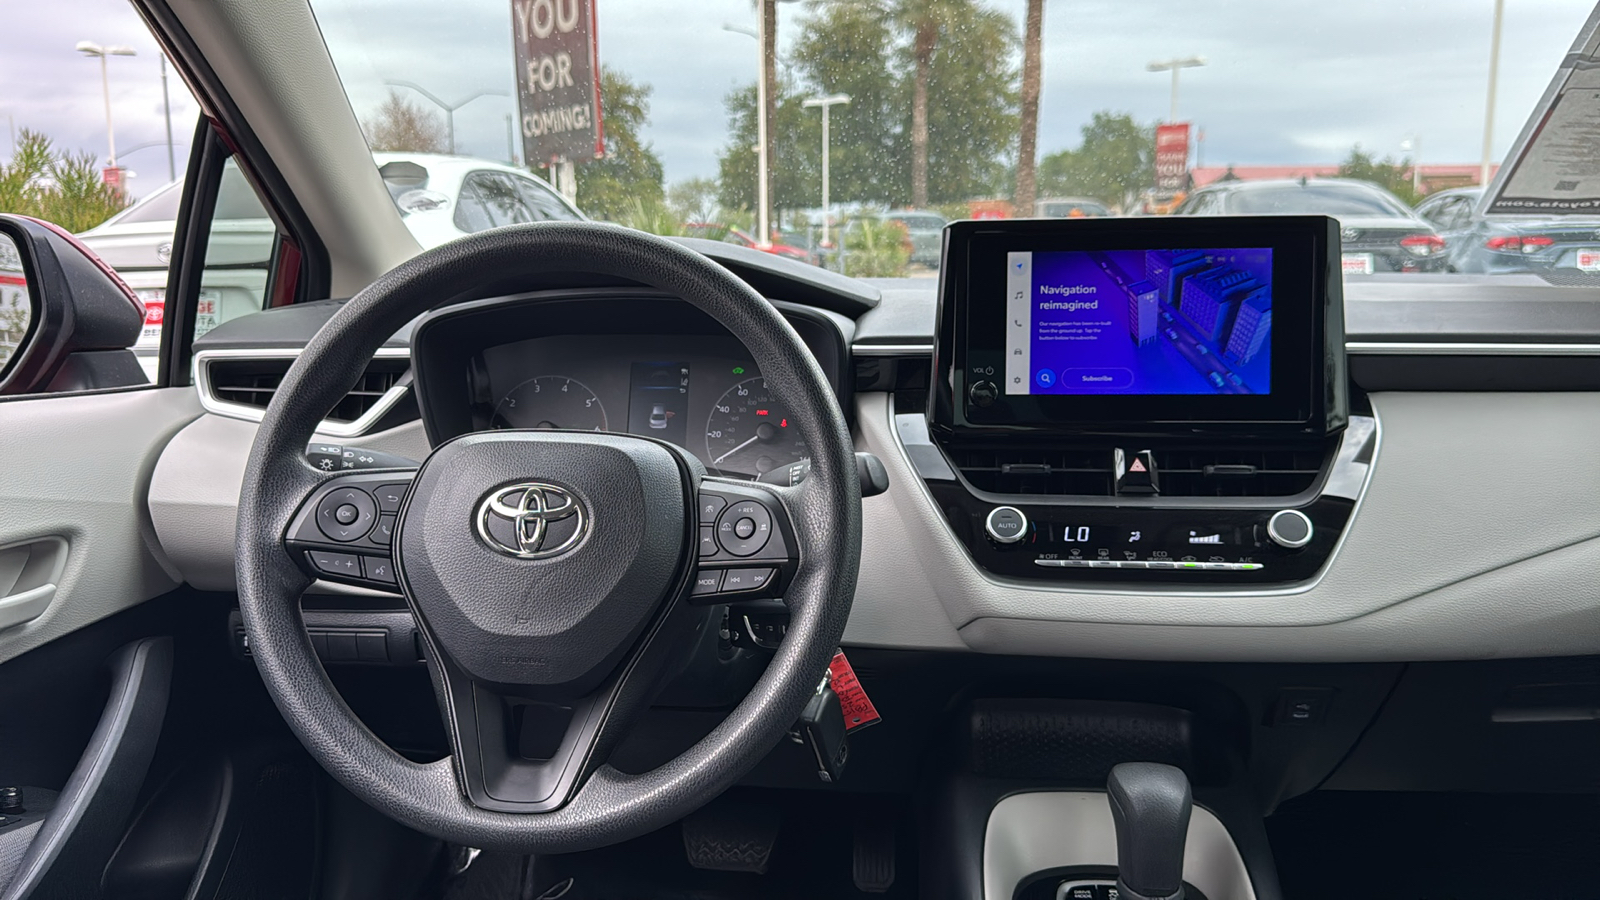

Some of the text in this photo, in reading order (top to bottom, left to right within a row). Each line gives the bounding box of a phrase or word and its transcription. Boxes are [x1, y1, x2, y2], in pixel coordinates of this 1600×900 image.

[516, 0, 580, 43] YOU
[527, 52, 574, 94] FOR
[523, 104, 591, 138] COMING!
[1040, 285, 1097, 296] Navigation
[1040, 300, 1098, 312] reimagined
[534, 384, 540, 393] 3
[561, 384, 568, 393] 4
[738, 388, 749, 396] 60
[509, 399, 516, 408] 2
[585, 399, 592, 408] 5
[719, 405, 730, 413] 40
[711, 430, 722, 438] 20
[1064, 526, 1090, 542] LO
